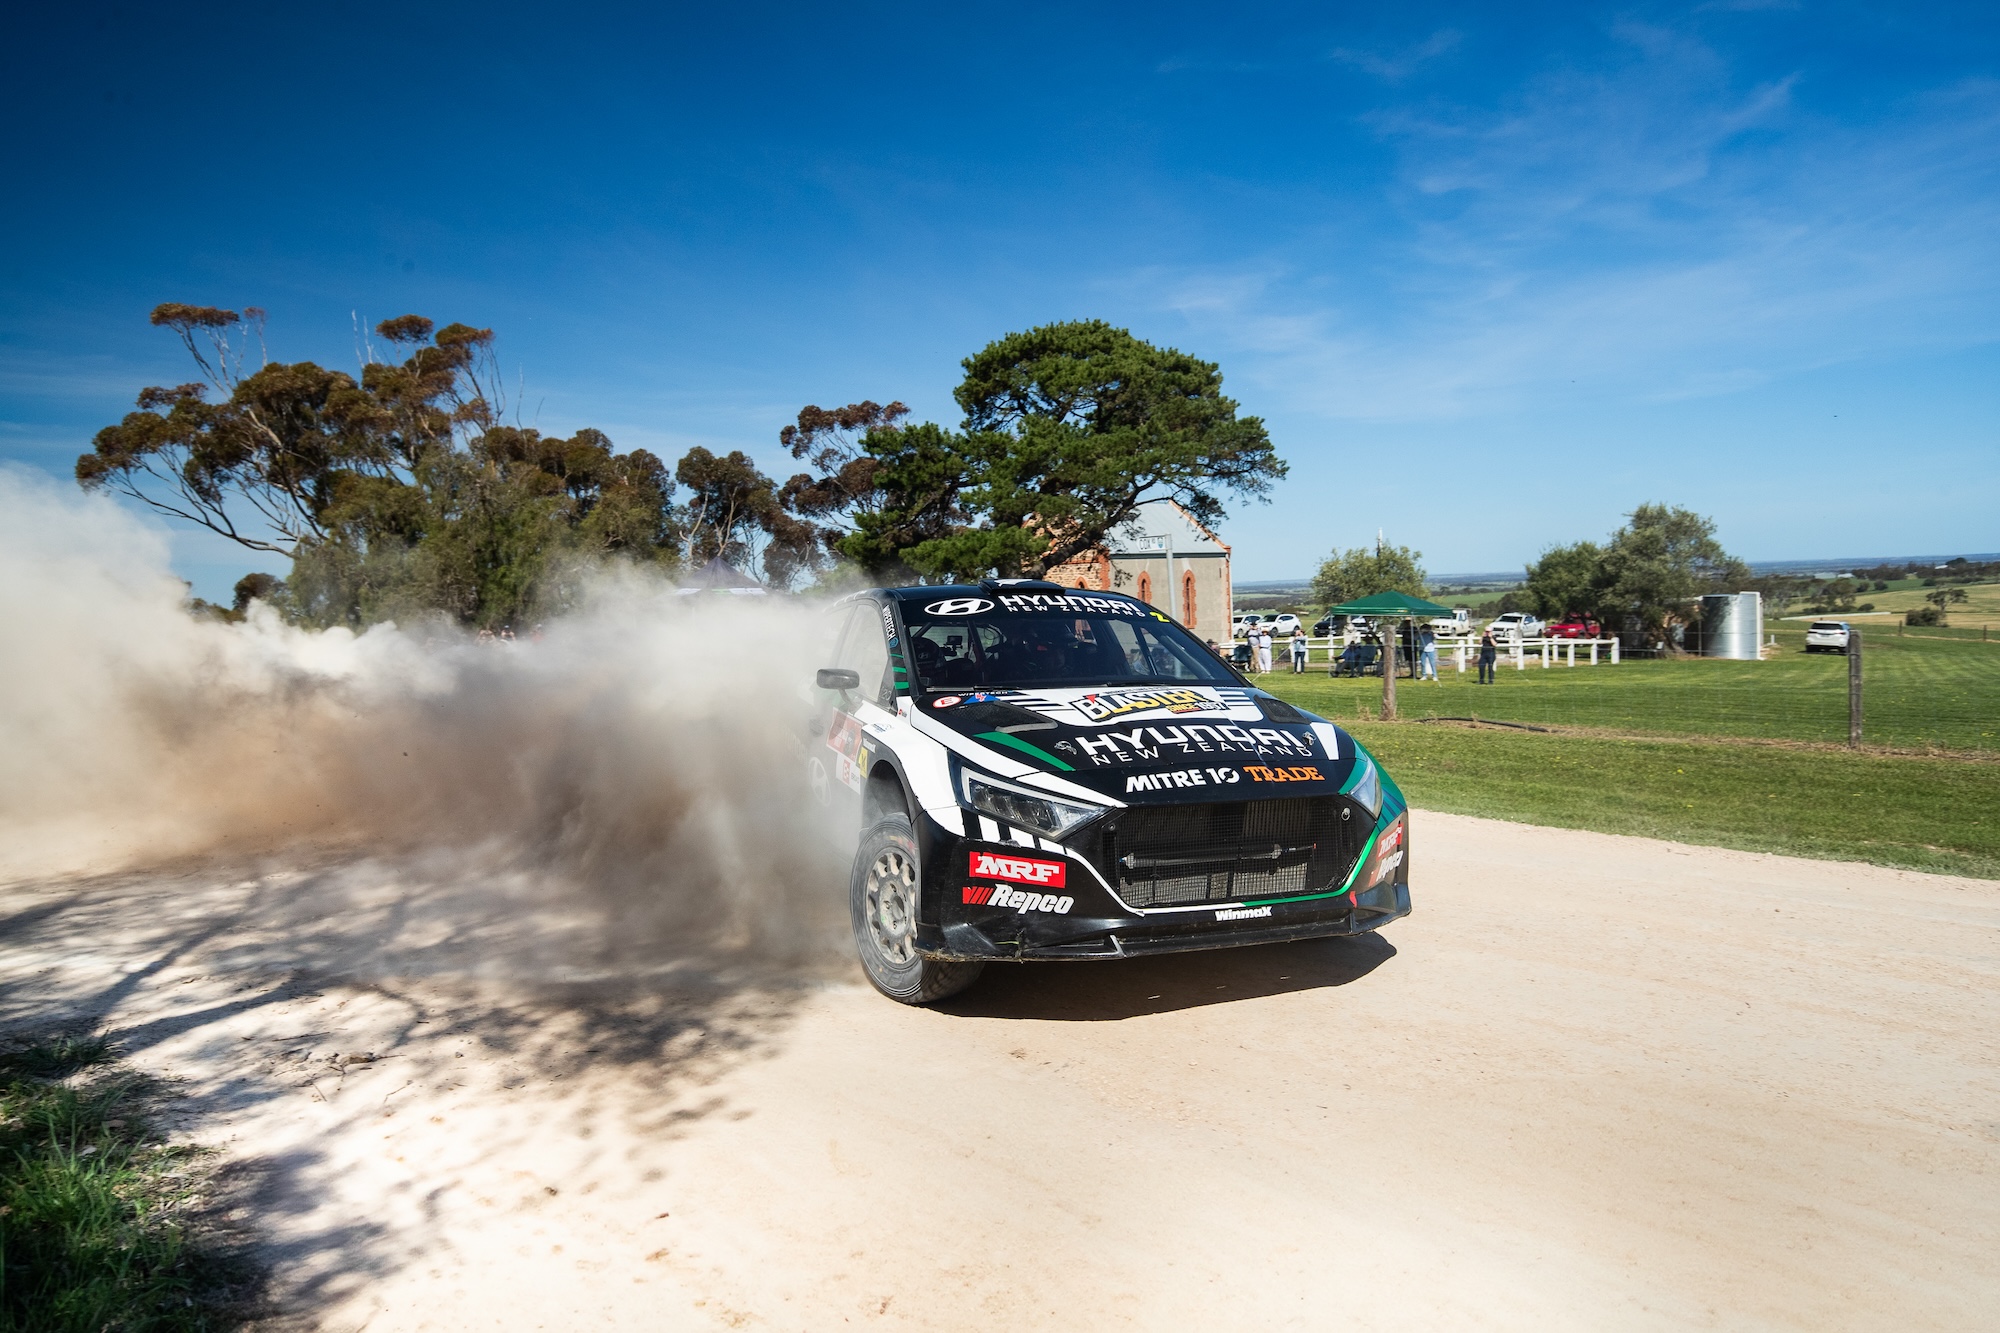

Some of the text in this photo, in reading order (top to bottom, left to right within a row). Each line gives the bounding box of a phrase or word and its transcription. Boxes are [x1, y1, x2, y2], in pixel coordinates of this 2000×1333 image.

[998, 594, 1141, 612] HYUNDAI
[1061, 605, 1145, 617] ZEALAND
[1149, 611, 1170, 623] 2
[1076, 725, 1305, 756] HYUNDAI
[1092, 743, 1313, 766] NEW ZEALAND
[1126, 767, 1241, 793] MITRE 10
[1243, 766, 1326, 782] TRADE
[975, 856, 1060, 882] MRF
[987, 884, 1075, 915] Repco
